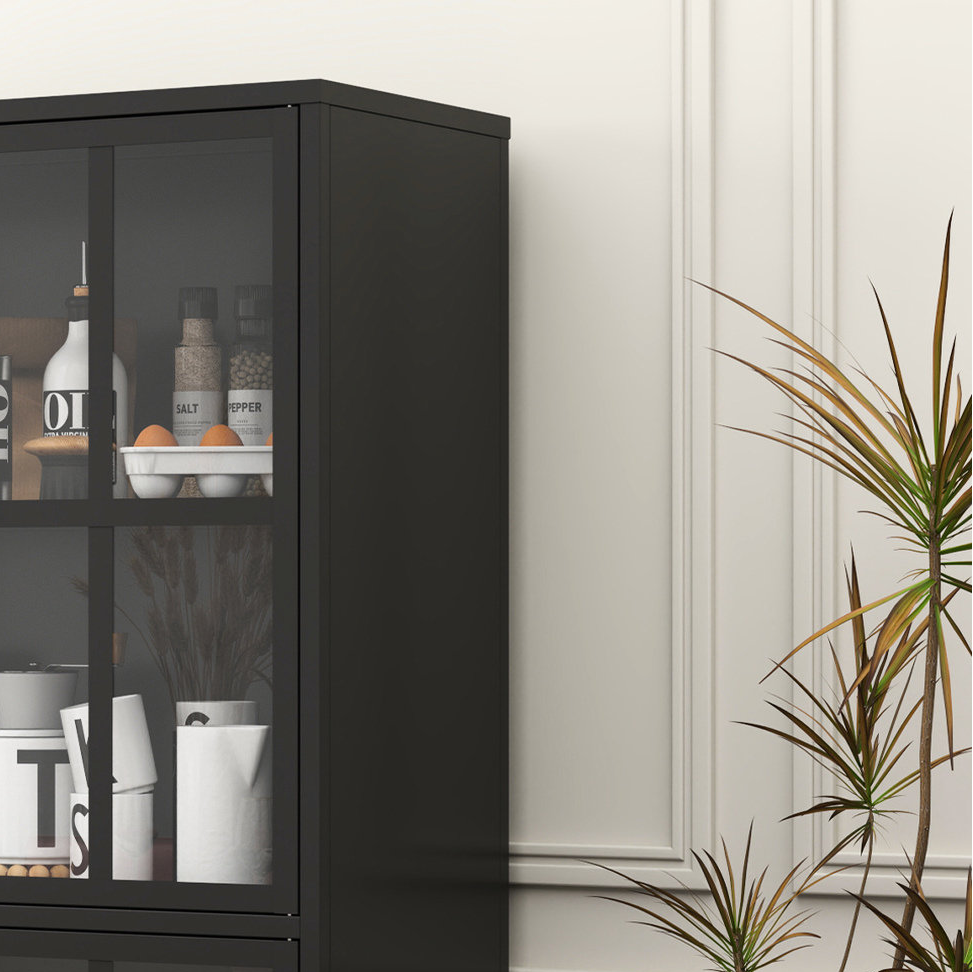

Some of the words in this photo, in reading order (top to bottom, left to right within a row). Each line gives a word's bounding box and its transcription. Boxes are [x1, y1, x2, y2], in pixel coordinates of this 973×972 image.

[44, 392, 89, 431] OI
[176, 403, 199, 414] SALT
[228, 402, 262, 413] PEPPER
[17, 749, 70, 848] T
